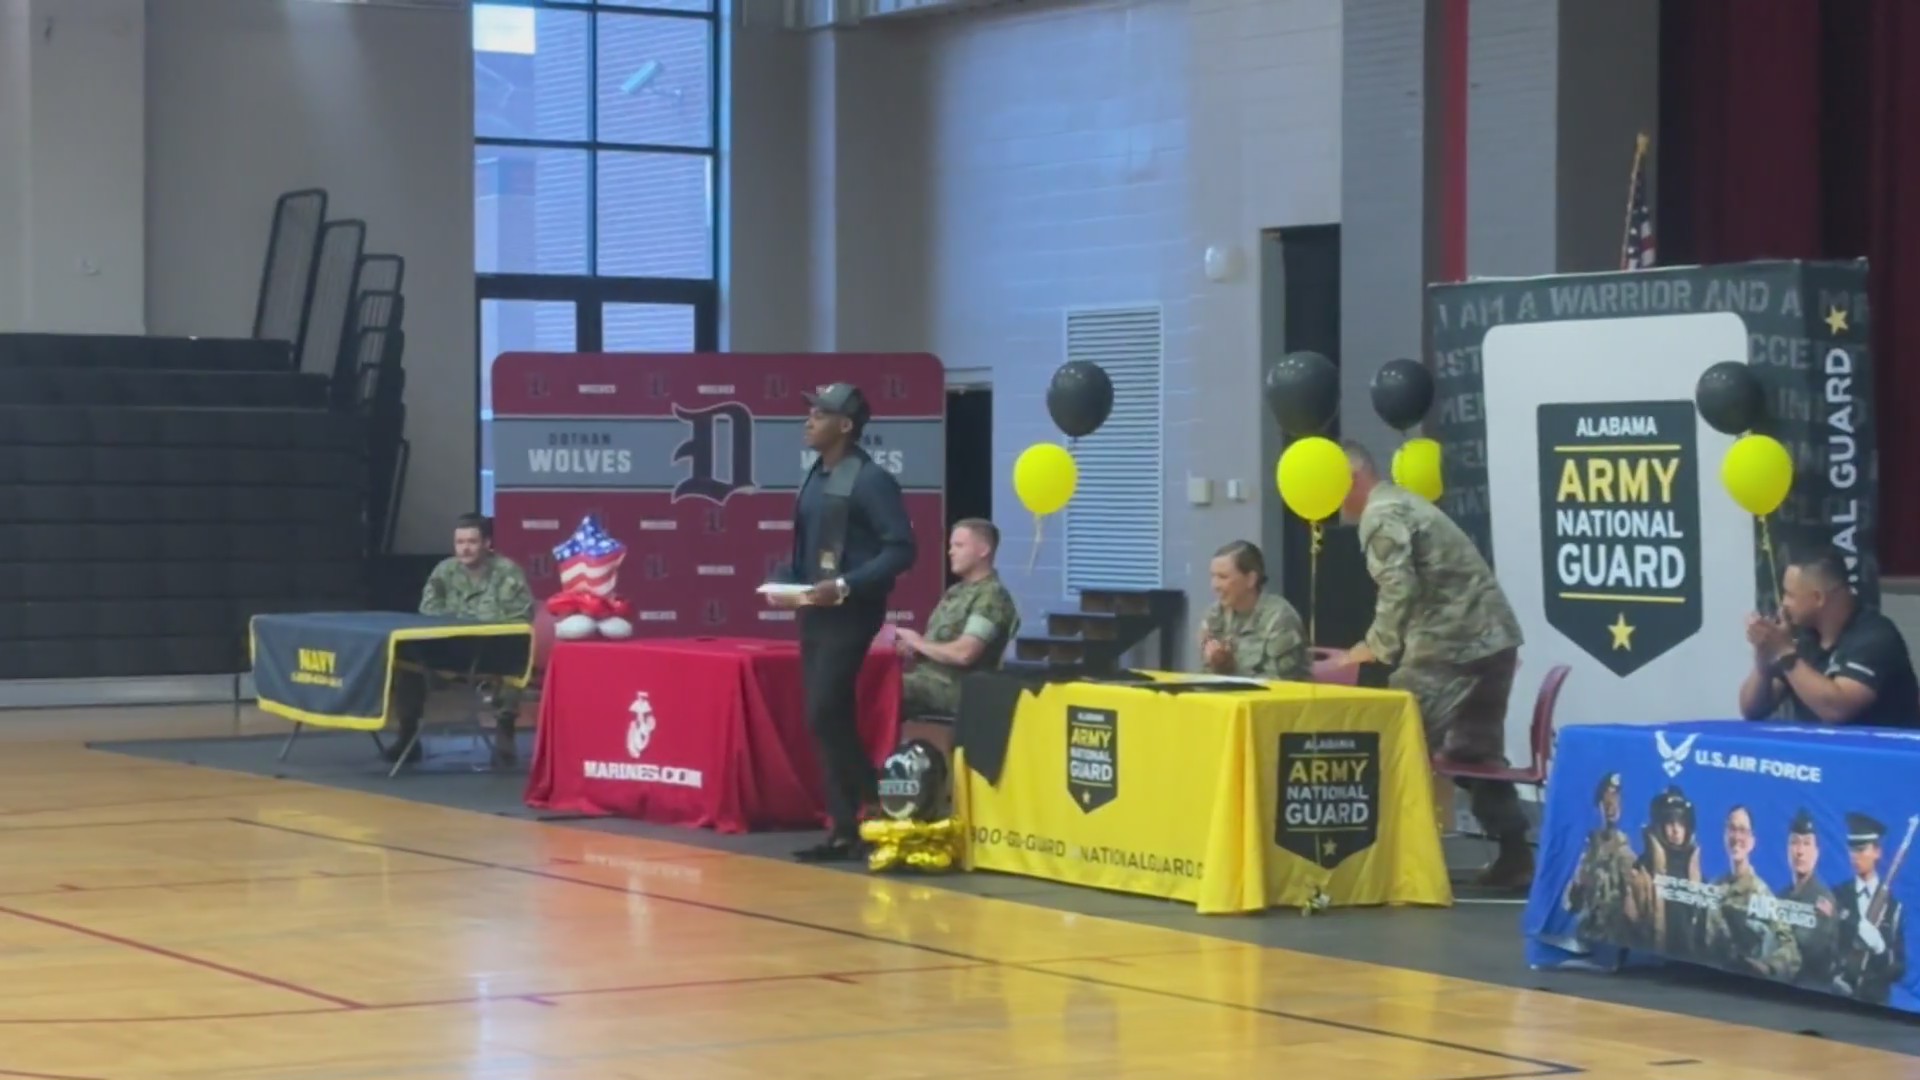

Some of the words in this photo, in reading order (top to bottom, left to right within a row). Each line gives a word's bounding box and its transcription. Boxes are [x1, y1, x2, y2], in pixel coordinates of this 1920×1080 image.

[1517, 290, 1538, 320] A
[1549, 279, 1692, 315] WARRIOR
[1704, 279, 1769, 313] AND
[1781, 287, 1803, 317] A
[1576, 416, 1658, 437] ALABAMA
[1825, 348, 1857, 488] GUARD
[548, 433, 611, 446] DOTHAN
[528, 449, 632, 473] WOLVES
[1557, 457, 1680, 503] ARMY
[1556, 509, 1683, 538] NATIONAL
[1557, 543, 1686, 588] GUARD
[298, 648, 336, 674] NAVY
[1071, 727, 1112, 748] ARMY
[1071, 760, 1113, 781] GUARD
[1289, 759, 1368, 782] ARMY
[1727, 754, 1757, 772] AIR
[1759, 758, 1822, 783] FORCE
[1287, 785, 1369, 800] NATIONAL
[1285, 803, 1369, 825] GUARD
[1748, 894, 1779, 920] AIR
